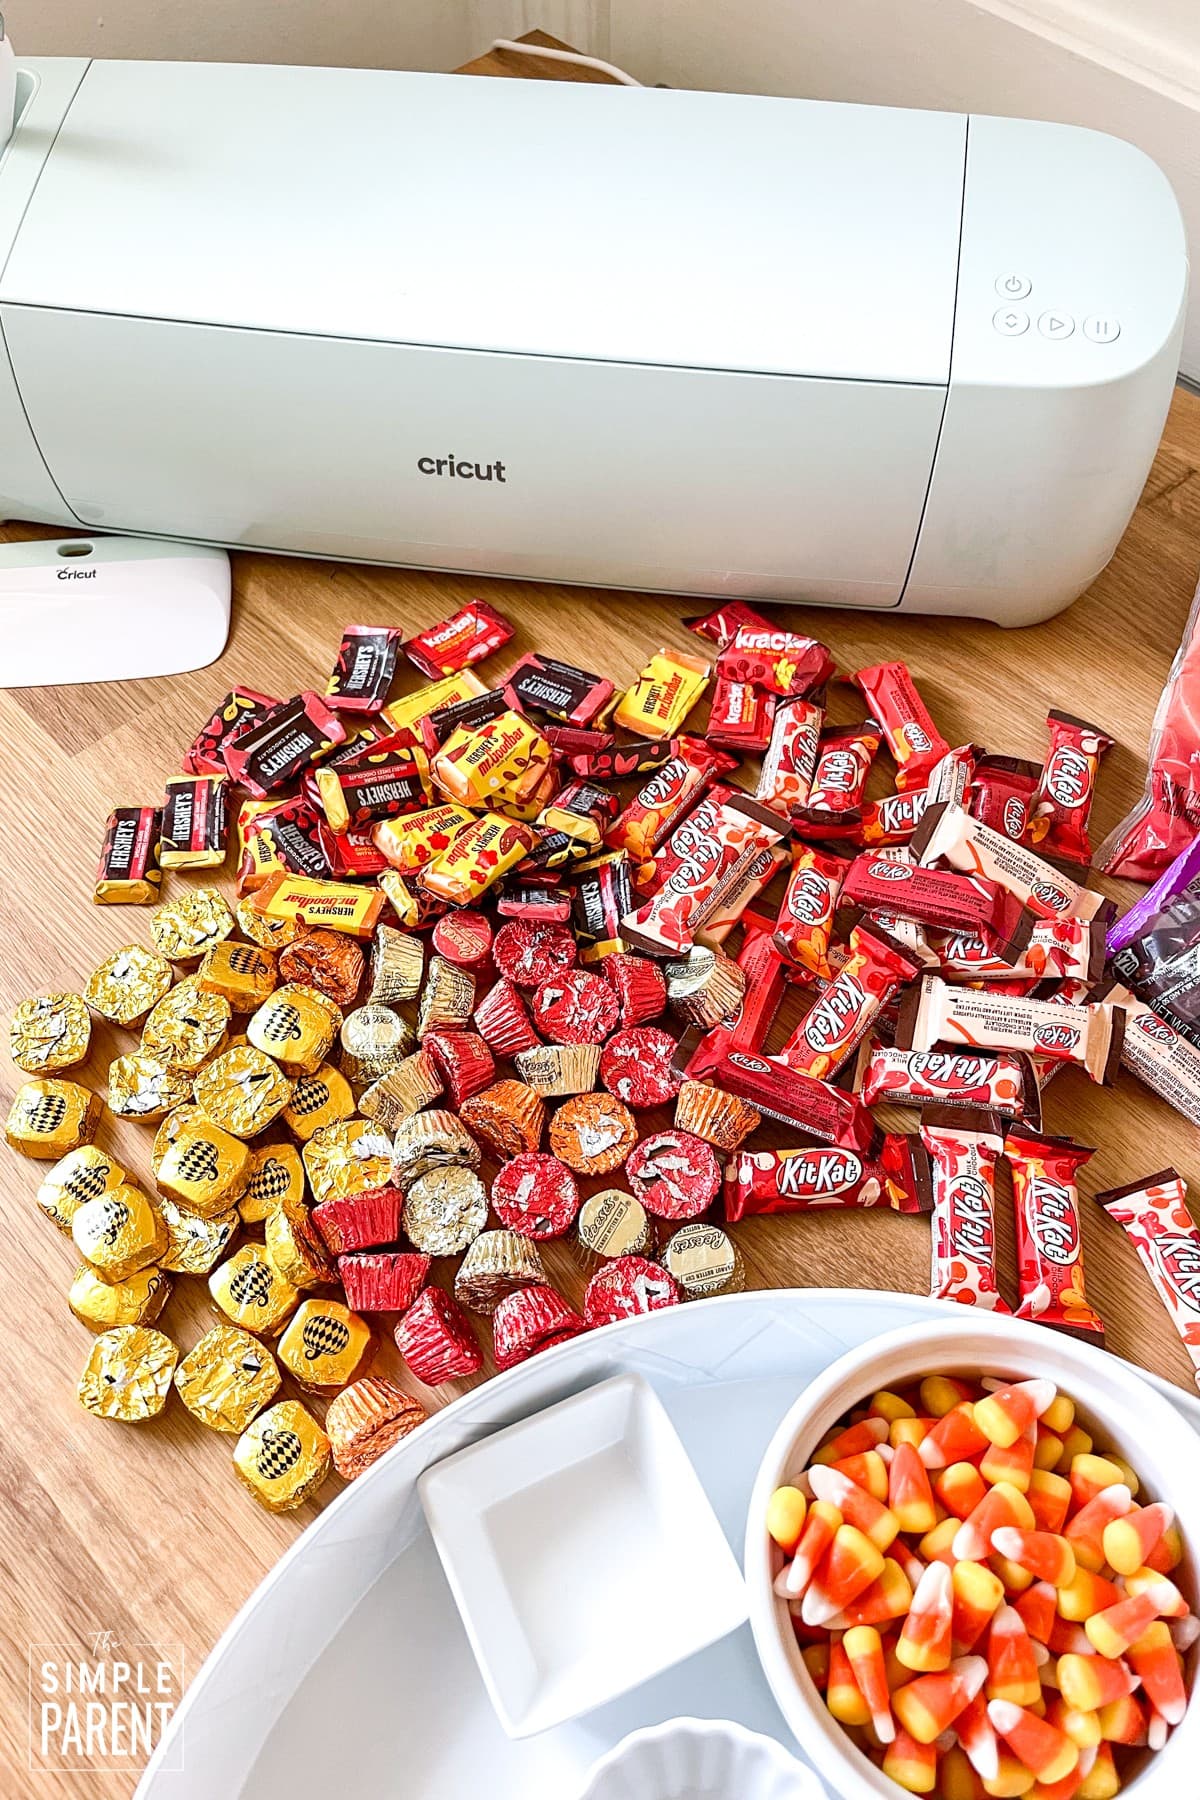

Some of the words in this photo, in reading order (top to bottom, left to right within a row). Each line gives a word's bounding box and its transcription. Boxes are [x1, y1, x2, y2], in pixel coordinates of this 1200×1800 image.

[418, 454, 506, 482] cricut
[56, 566, 96, 580] Cricut
[347, 645, 374, 690] HERSHEY'S
[516, 677, 572, 707] HERSHEY'S
[255, 738, 285, 761] CHOCOLATE
[284, 728, 297, 740] MILK
[466, 736, 499, 764] HERSHEY'S
[257, 731, 315, 778] HERSHEY'S
[477, 726, 525, 777] mr.Goodbar
[355, 780, 411, 805] HERSHEY'S
[172, 792, 192, 841] HERSHEY'S
[402, 805, 454, 834] mr.Goodbar
[884, 791, 927, 830] KitK
[108, 817, 136, 870] HERSHEY'S
[280, 823, 327, 872] HERSHEY'S
[445, 819, 487, 867] mr.Goodbar
[471, 824, 502, 853] HERSHEY'S
[669, 835, 724, 895] KitKat
[283, 893, 358, 911] mr.Goodbar
[308, 906, 355, 917] HERSHEY'S
[580, 880, 605, 933] HERSHEY'S
[794, 868, 829, 921] KitKat
[1034, 883, 1071, 911] KitKat
[806, 974, 866, 1047] KitKat
[1035, 1026, 1081, 1048] KitKat
[914, 1052, 997, 1086] KitKat
[781, 1155, 859, 1194] KitKat
[966, 1142, 979, 1175] CHOCOLAT
[953, 1181, 992, 1266] KitKat
[1034, 1175, 1074, 1260] KitKat
[672, 1231, 725, 1255] Reese's
